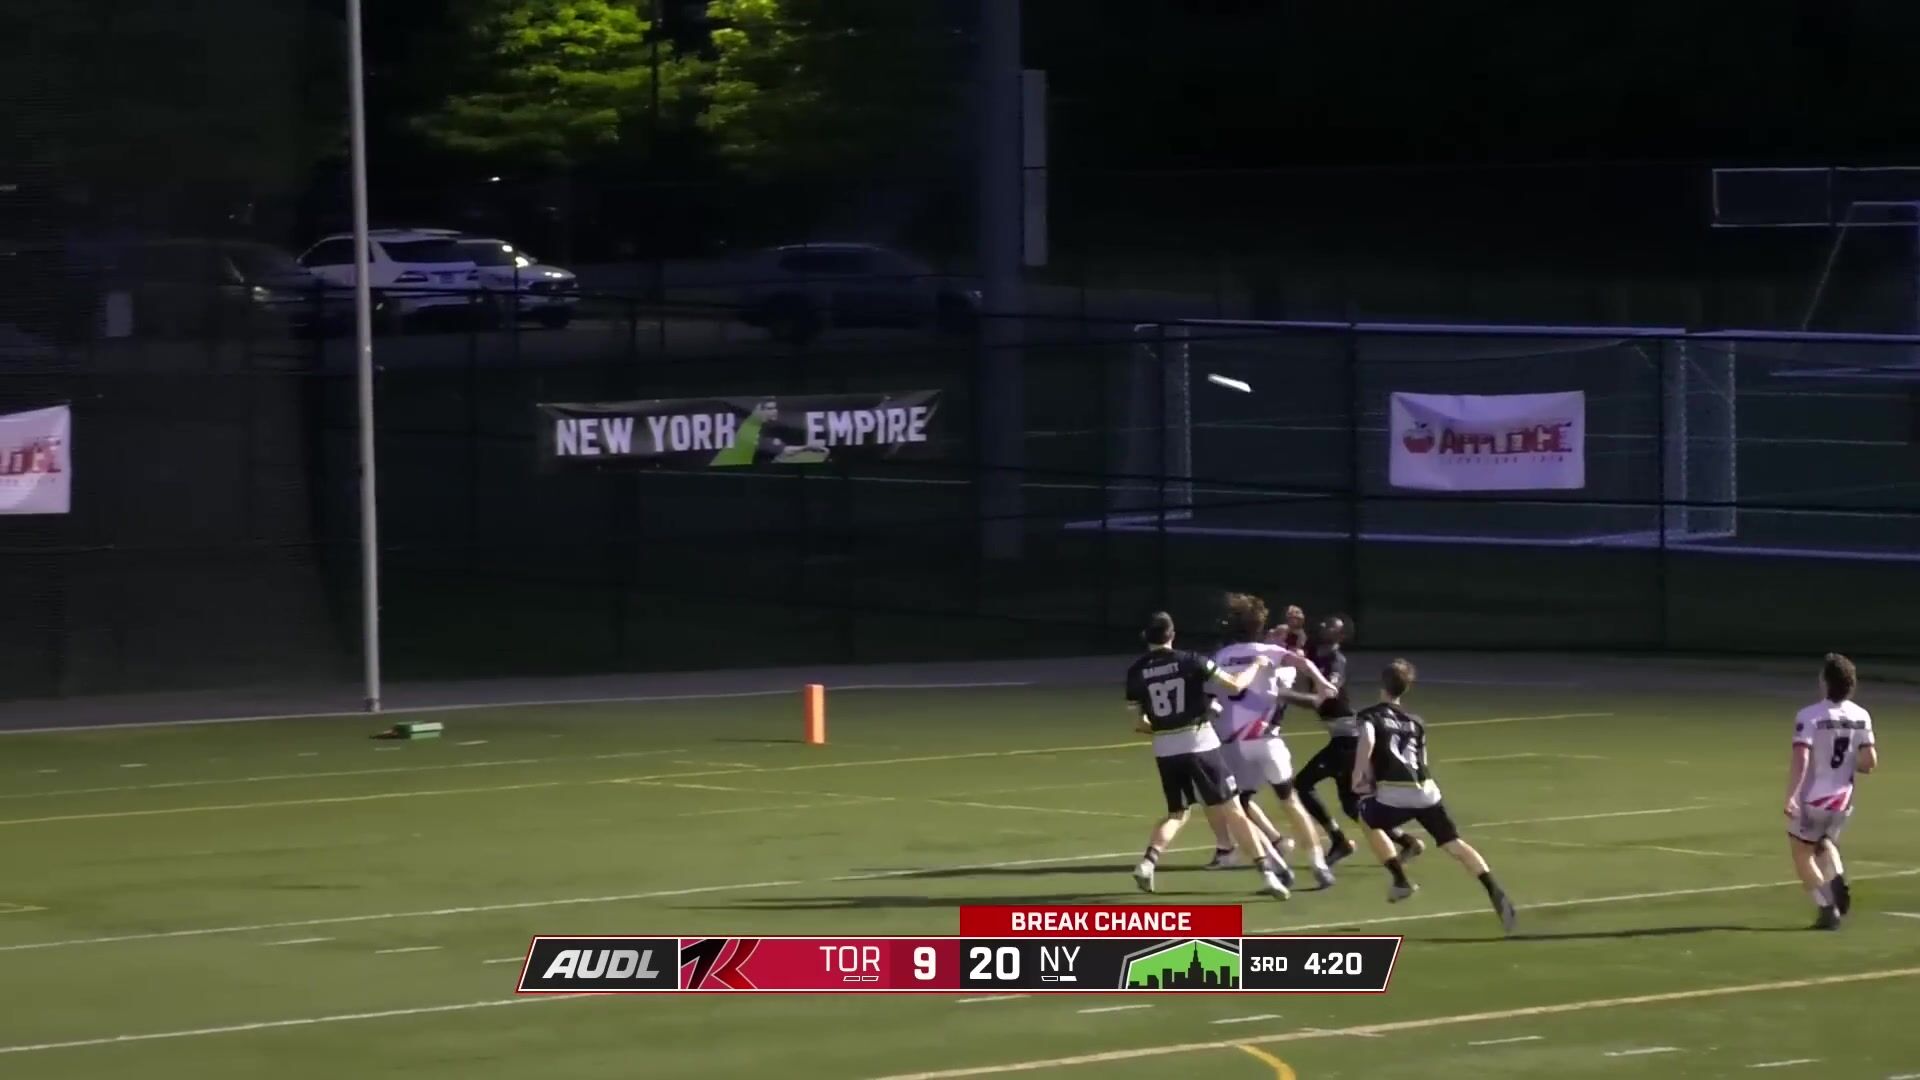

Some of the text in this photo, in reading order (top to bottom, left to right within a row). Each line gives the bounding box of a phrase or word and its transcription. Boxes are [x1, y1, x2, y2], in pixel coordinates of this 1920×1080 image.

[556, 406, 929, 456] NEW YORK EMPIRE
[1148, 677, 1186, 717] 87
